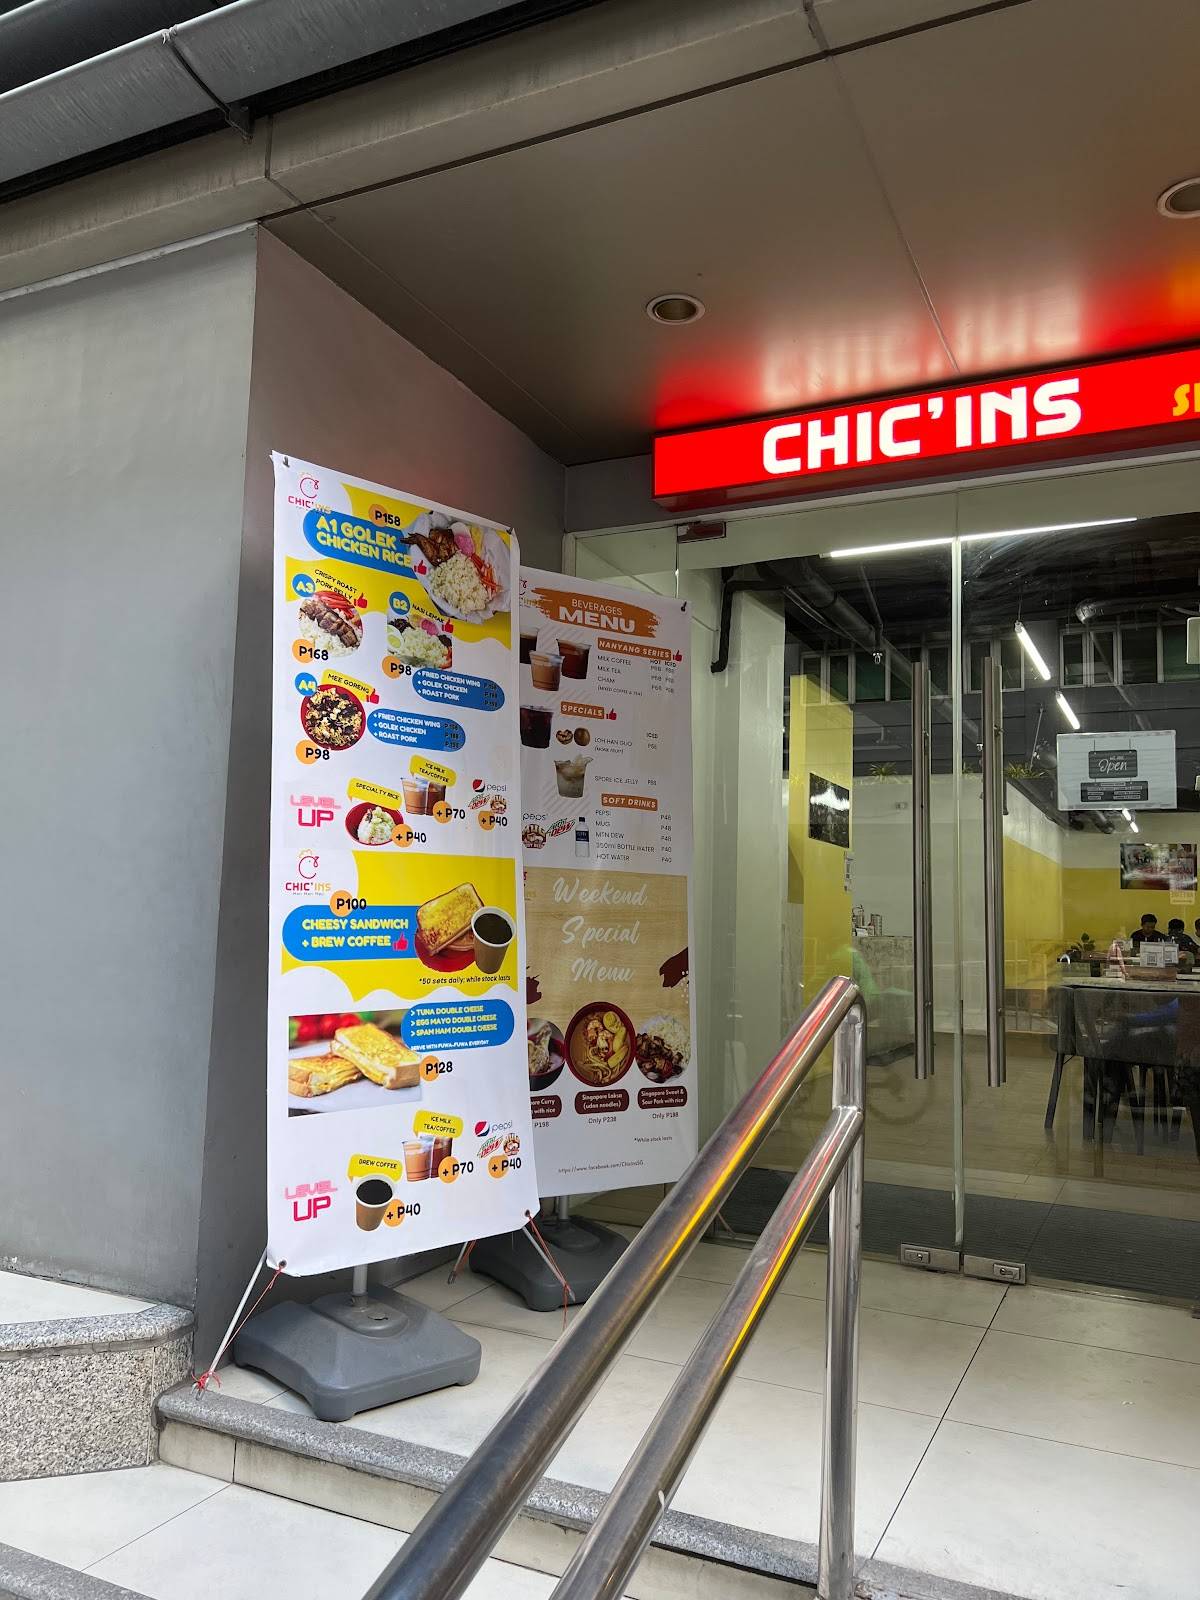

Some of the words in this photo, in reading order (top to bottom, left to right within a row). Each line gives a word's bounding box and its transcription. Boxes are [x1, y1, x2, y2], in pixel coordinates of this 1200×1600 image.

[762, 377, 1082, 475] CHIC'INS
[375, 510, 400, 526] P158
[316, 516, 338, 534] A1
[341, 522, 396, 550] GOLEK
[316, 531, 379, 559] CHICKEN
[383, 548, 412, 567] RICE
[296, 581, 314, 594] A3
[314, 569, 336, 581] CRISPY
[337, 579, 357, 593] ROAST
[315, 579, 333, 590] PORK
[333, 587, 353, 599] BELLY
[572, 599, 623, 615] BEVERAGES
[412, 604, 426, 614] NASI
[426, 610, 444, 624] LEMAK
[559, 606, 635, 633] MENU
[299, 645, 329, 660] P168
[599, 641, 640, 653] NANYANG
[643, 648, 670, 658] SERIES
[611, 657, 631, 666] COFFEE
[390, 662, 412, 676] P98
[328, 673, 343, 683] MEE
[344, 678, 370, 694] GORENG
[422, 671, 439, 679] FRIED
[440, 673, 465, 685] CHICKEN
[465, 678, 480, 688] WING
[422, 680, 442, 689] GOLEK
[443, 683, 468, 694] CHICKEN
[422, 689, 443, 698] ROAST
[444, 693, 459, 701] PORK
[561, 703, 603, 717] SPECIALS
[378, 713, 395, 721] FRIED
[396, 716, 423, 726] CHICKEN
[423, 719, 441, 728] WING
[378, 722, 398, 731] GOLEK
[399, 725, 426, 735] CHICKEN
[379, 732, 400, 740] ROAST
[401, 735, 418, 744] PORK
[305, 747, 330, 760] P98
[1098, 758, 1127, 774] Open
[419, 767, 449, 783] TEA/COFFEE
[355, 782, 386, 796] SPECIALTY
[386, 791, 400, 801] RICE
[486, 784, 507, 792] pepsi
[602, 796, 625, 807] SOFT
[628, 798, 656, 809] DRINKS
[298, 809, 334, 828] UP
[445, 808, 466, 820] P70
[489, 816, 508, 827] P40
[406, 831, 427, 844] P40
[617, 843, 635, 851] BOTTLE
[636, 845, 655, 853] WATER
[285, 882, 332, 891] CHIC'INS
[553, 877, 647, 906] Weekend
[336, 898, 367, 911] P100
[302, 918, 349, 930] CHEESY
[350, 918, 409, 930] SANDWICH
[561, 915, 640, 948] Special
[311, 936, 345, 948] BREW
[347, 935, 391, 947] COFFEE
[571, 957, 634, 983] Menu
[466, 975, 480, 983] while
[436, 1007, 463, 1015] DOUBLE
[464, 1005, 484, 1013] CHEESE
[416, 1019, 430, 1027] EGG
[430, 1017, 451, 1026] MAYO
[452, 1015, 476, 1024] DOUBLE
[477, 1014, 497, 1022] CHEESE
[416, 1028, 434, 1036] SPAM
[435, 1027, 451, 1035] HAM
[452, 1025, 477, 1034] DOUBLE
[437, 1041, 468, 1049] FUWA-FUWA
[425, 1061, 453, 1075] P128
[582, 1094, 607, 1102] Singapore
[641, 1089, 665, 1098] Singapore
[540, 1098, 555, 1106] Curry
[598, 1101, 622, 1109] noodles)
[588, 1117, 601, 1125] Only
[652, 1112, 665, 1120] Only
[423, 1123, 456, 1134] TEA/COFFEE
[491, 1120, 513, 1133] pepsi
[358, 1158, 374, 1167] BREW
[374, 1160, 398, 1170] COFFEE
[452, 1162, 474, 1176] P70
[501, 1157, 522, 1171] P40
[293, 1196, 331, 1222] UP
[397, 1203, 421, 1217] P40
